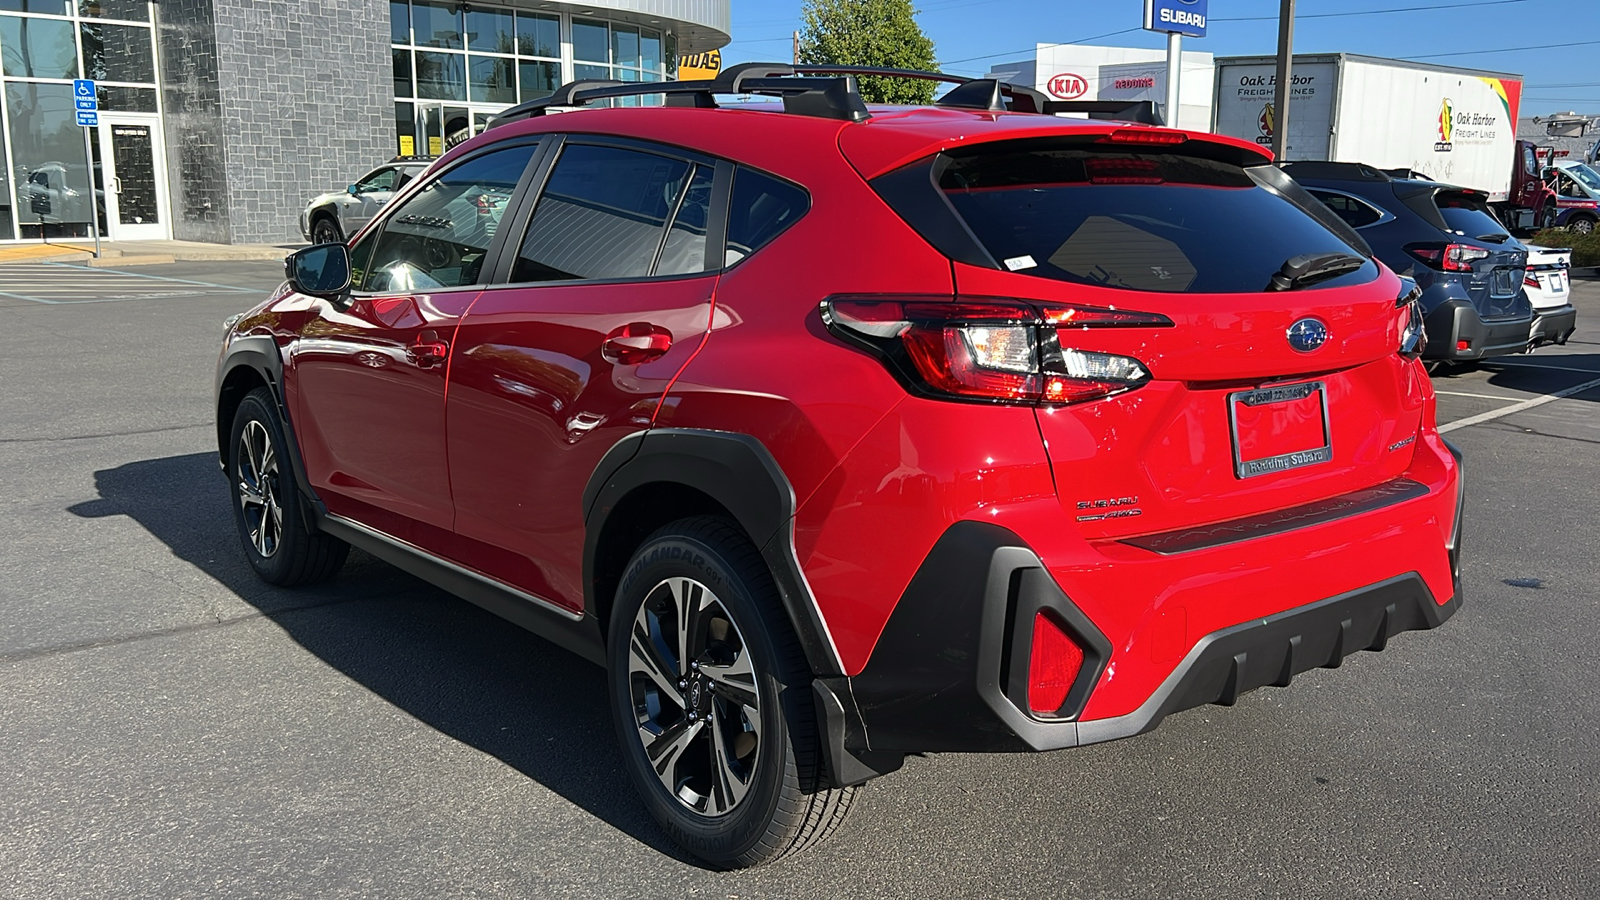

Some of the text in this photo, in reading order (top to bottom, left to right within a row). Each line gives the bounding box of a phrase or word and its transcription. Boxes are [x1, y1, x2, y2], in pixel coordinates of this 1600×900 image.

[1160, 8, 1206, 29] SUBARU
[677, 53, 720, 70] IDAS
[1054, 79, 1082, 94] KIA
[1114, 78, 1156, 89] REDDING
[1240, 75, 1265, 86] Oak
[1237, 88, 1276, 96] FREIGH
[1456, 112, 1496, 126] Oak Harbor
[1455, 129, 1496, 139] FREIGHT LINES
[1249, 451, 1323, 474] Redding Subaru
[1076, 496, 1139, 509] SUBARU
[622, 546, 706, 594] GEOLANDAR
